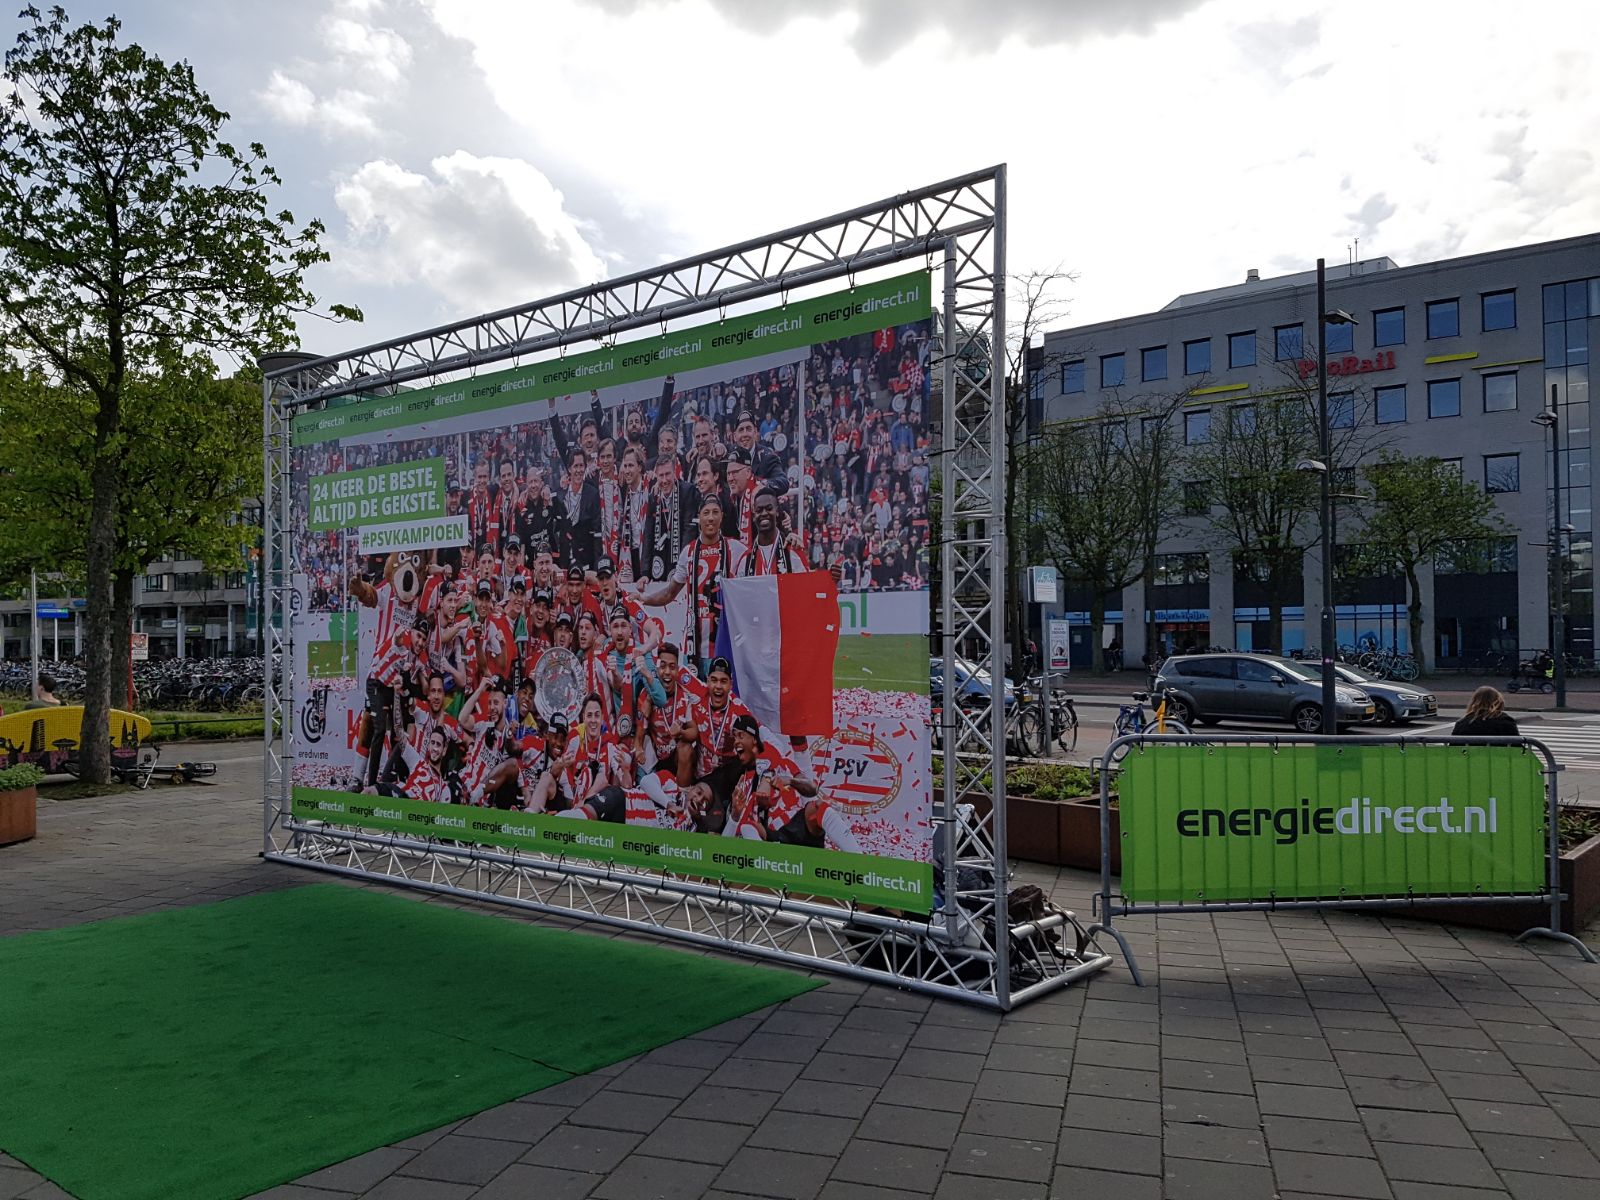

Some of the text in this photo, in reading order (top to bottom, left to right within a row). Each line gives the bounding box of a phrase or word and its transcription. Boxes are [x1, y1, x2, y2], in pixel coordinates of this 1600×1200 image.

[813, 286, 919, 325] energiedirect.nl
[711, 315, 802, 348] energiedirect.nl
[622, 339, 702, 367] energiedirect.nl
[1298, 351, 1396, 379] PoRail
[543, 358, 614, 384] energiedirect.nl
[472, 376, 535, 398] energiedirect.nl
[408, 391, 465, 411] energiedirect.nl
[313, 467, 438, 502] 24 KEER DE BESTE,
[313, 491, 440, 526] ALTIJD DE GEKSTE.
[362, 522, 464, 548] #PSVKAMPIOEN
[833, 757, 869, 777] PSV
[350, 804, 402, 821] energiedirect.nl
[408, 811, 466, 828] energiedirect.nl
[1176, 797, 1497, 845] energiedirect.nl
[472, 819, 536, 838] energiedirect.nl
[543, 829, 614, 849] energiedirect.nl
[622, 841, 702, 860] energiedirect.nl
[712, 852, 803, 876] energiedirect.nl
[814, 866, 921, 894] energiedirect.nl
